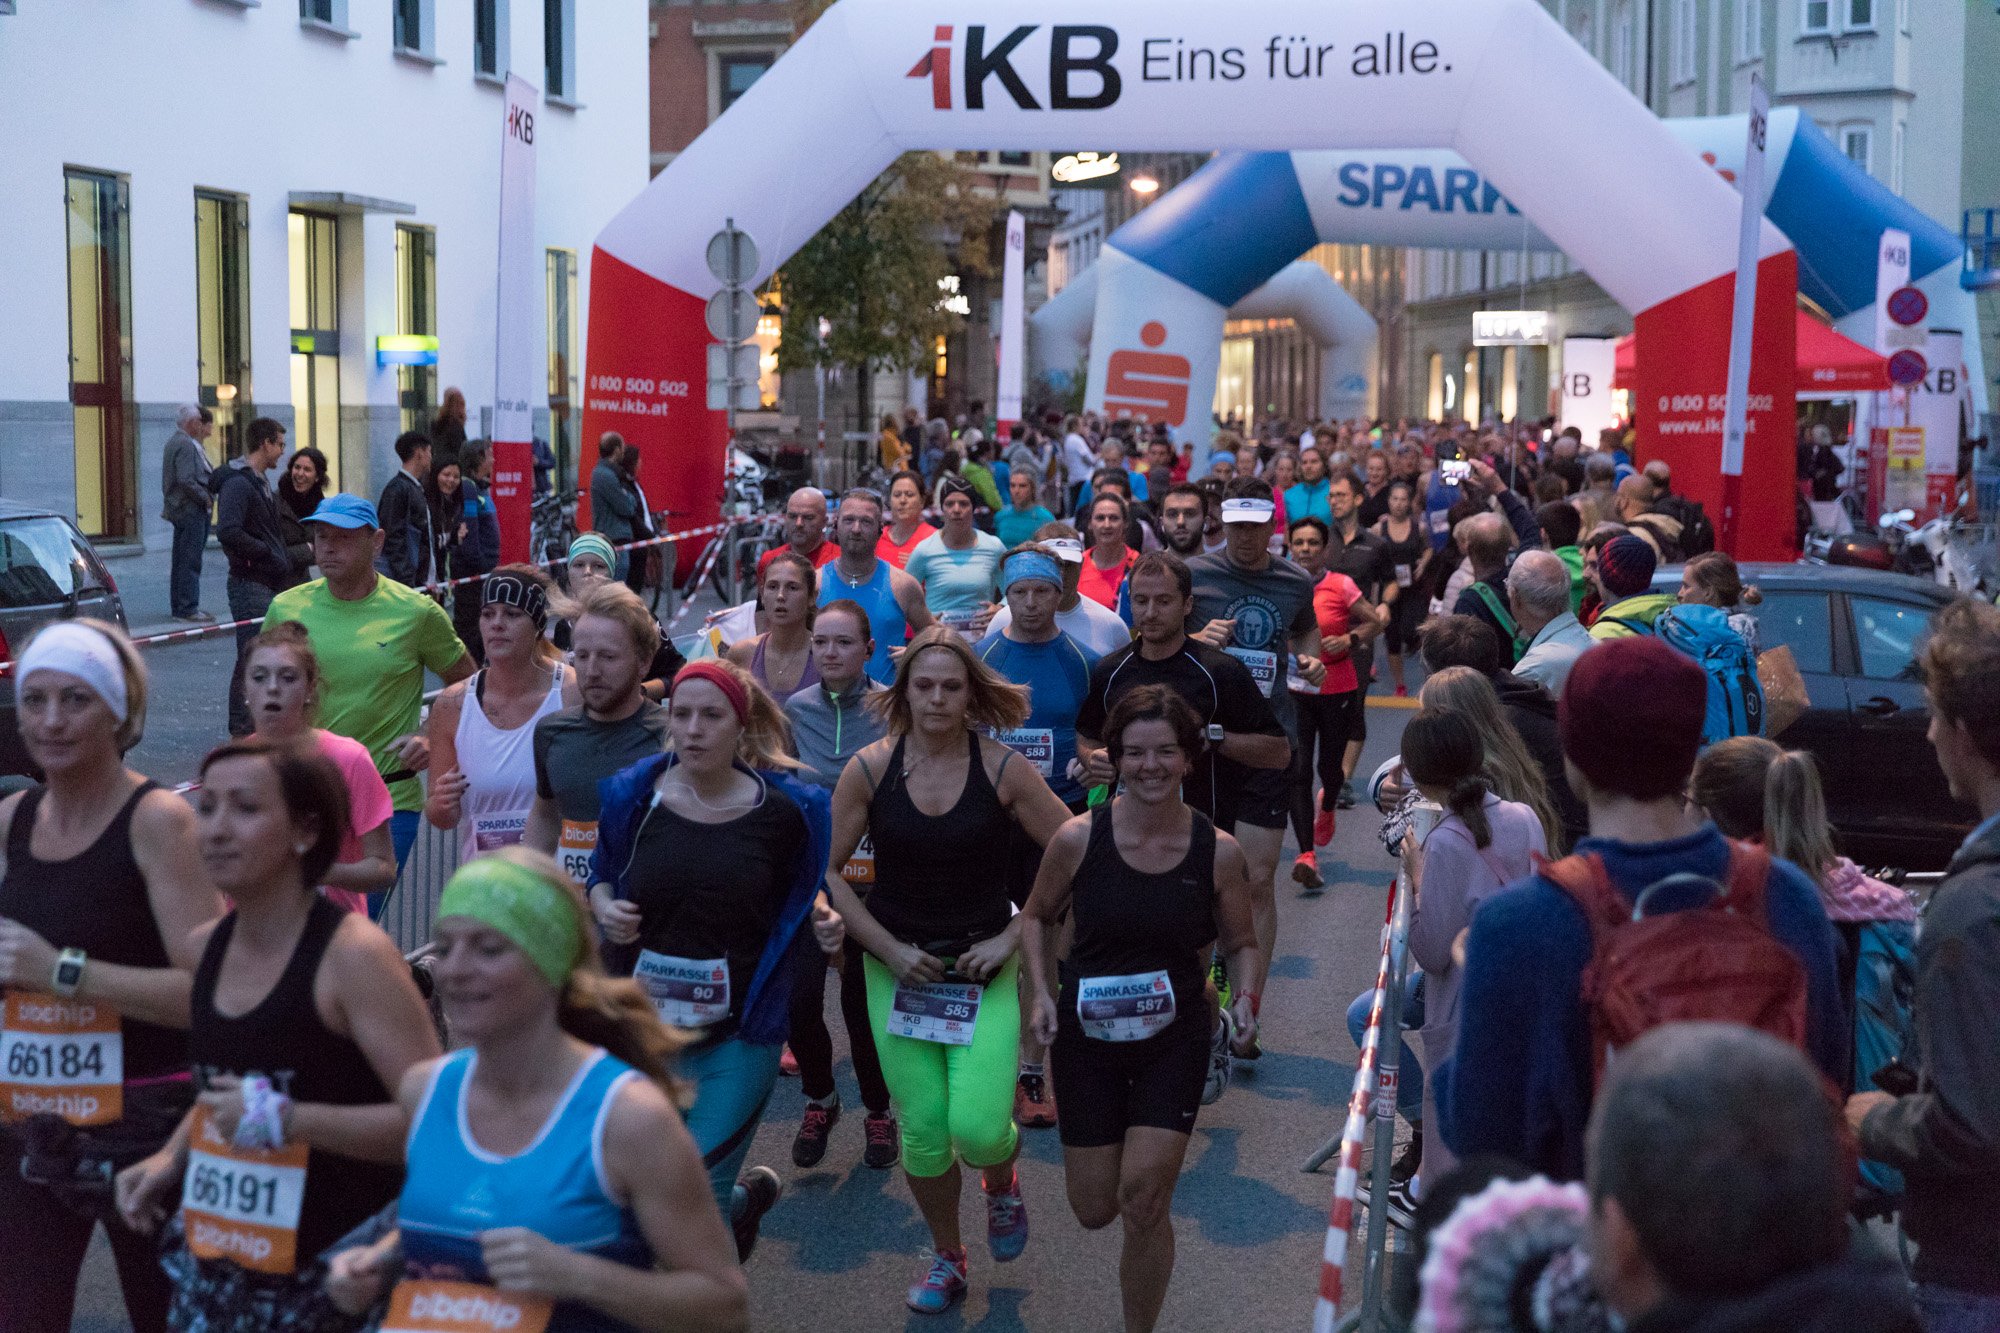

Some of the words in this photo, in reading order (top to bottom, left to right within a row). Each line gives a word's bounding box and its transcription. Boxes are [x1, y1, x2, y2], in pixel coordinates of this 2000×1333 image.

[1143, 39, 1246, 81] Eins
[1265, 36, 1334, 78] für
[1352, 32, 1452, 76] alle.
[590, 375, 598, 390] 0
[599, 376, 622, 392] 800
[625, 377, 655, 394] 500
[659, 380, 688, 397] 502
[589, 397, 668, 417] www.ikb.at
[1658, 395, 1669, 413] 0
[1671, 394, 1703, 412] 800
[1707, 394, 1727, 411] 50
[1251, 669, 1269, 679] 553
[993, 734, 1040, 743] ARKASSE
[1025, 747, 1045, 757] 588
[564, 854, 595, 879] 66
[641, 960, 711, 981] SPARKASSE
[693, 986, 714, 999] 90
[1083, 982, 1154, 998] SPARKASSE
[944, 1003, 969, 1018] 585
[1136, 998, 1164, 1013] 587
[8, 1041, 103, 1077] 66184
[193, 1163, 278, 1216] 66191
[410, 1292, 522, 1330] bibchip
